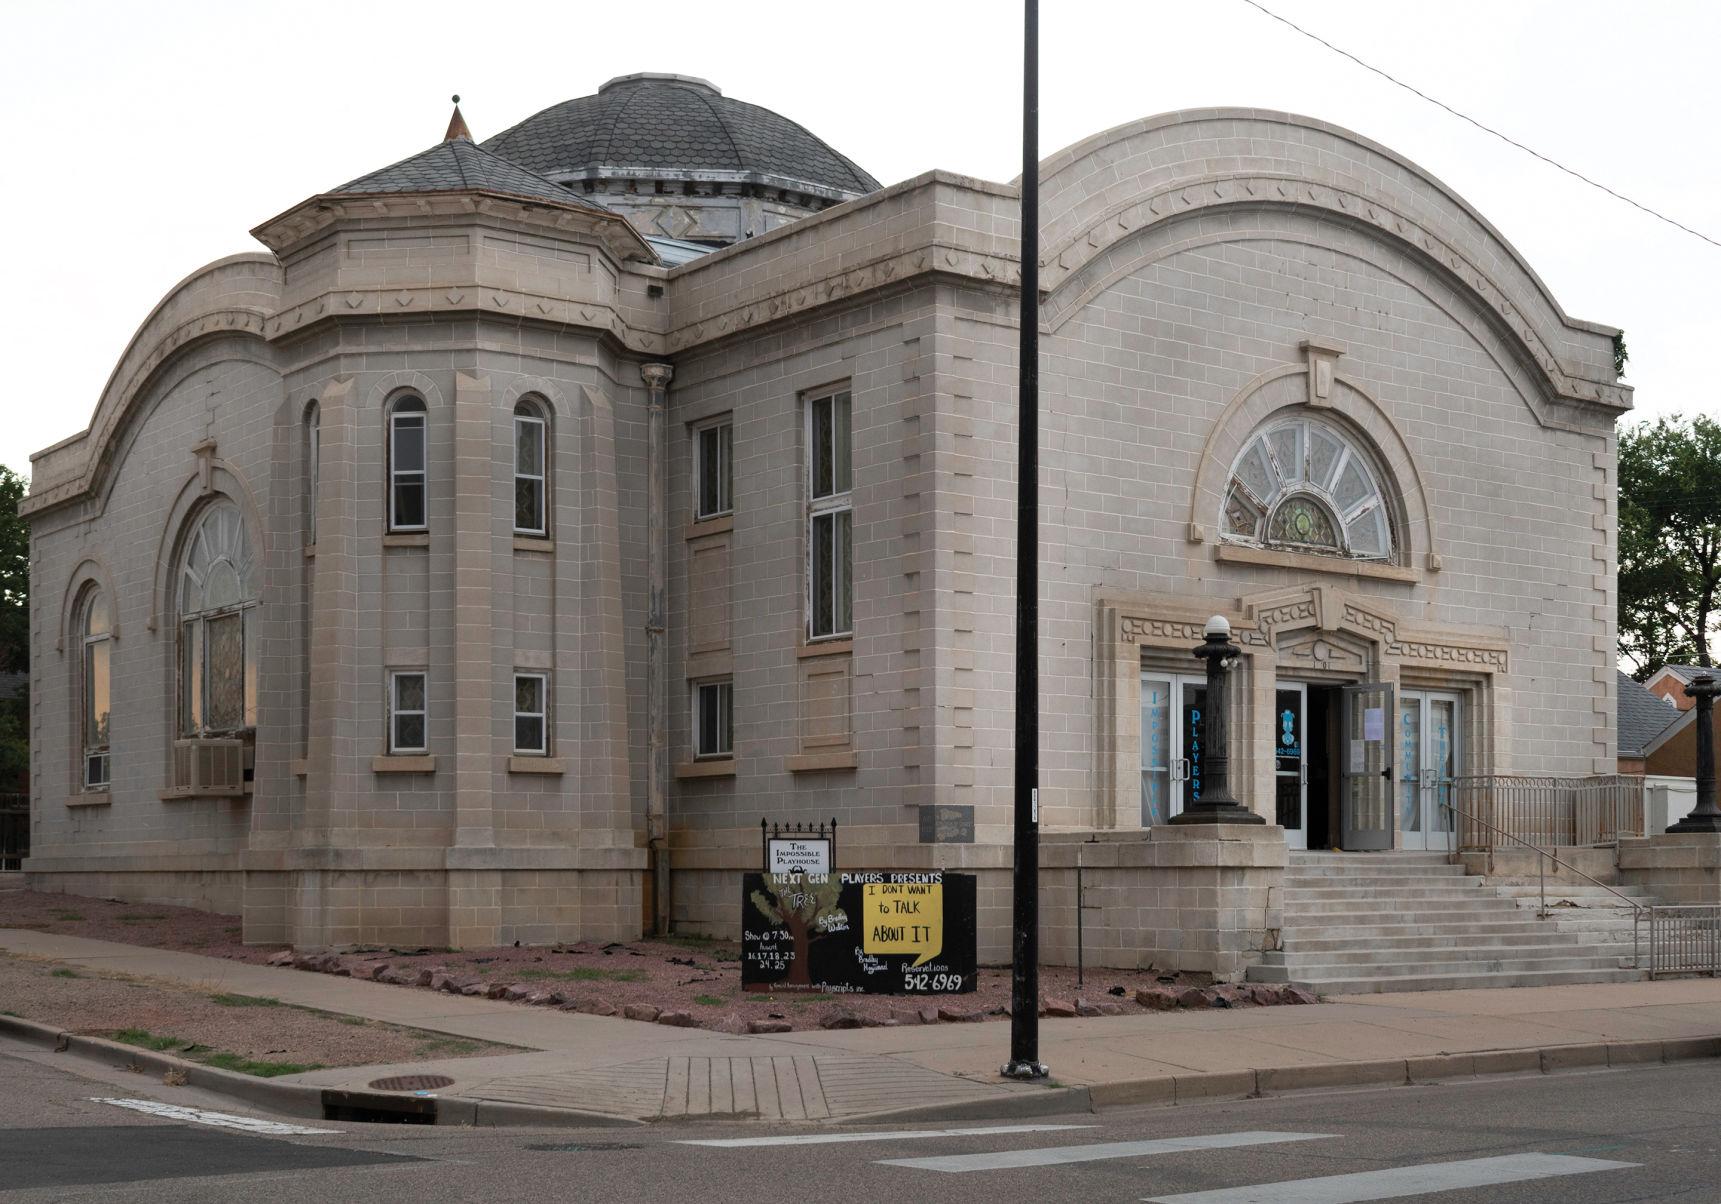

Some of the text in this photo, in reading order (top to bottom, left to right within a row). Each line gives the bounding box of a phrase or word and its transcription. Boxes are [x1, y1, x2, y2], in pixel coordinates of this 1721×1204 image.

[1191, 709, 1201, 801] PLAYERS
[1276, 748, 1301, 756] 42-696
[776, 849, 821, 857] IMPOSSIBLE
[776, 857, 821, 865] PLAYHOUSE
[773, 873, 943, 884] NEXT GEN PLAYERS PRESENTS
[868, 886, 876, 896] I
[907, 885, 933, 895] WANT
[788, 892, 817, 909] TREE
[878, 900, 921, 914] to TALK
[818, 916, 828, 928] By
[745, 930, 761, 941] Show
[872, 925, 932, 943] ABOUT IT
[902, 962, 949, 973] Reservations
[904, 974, 963, 991] 542-6969
